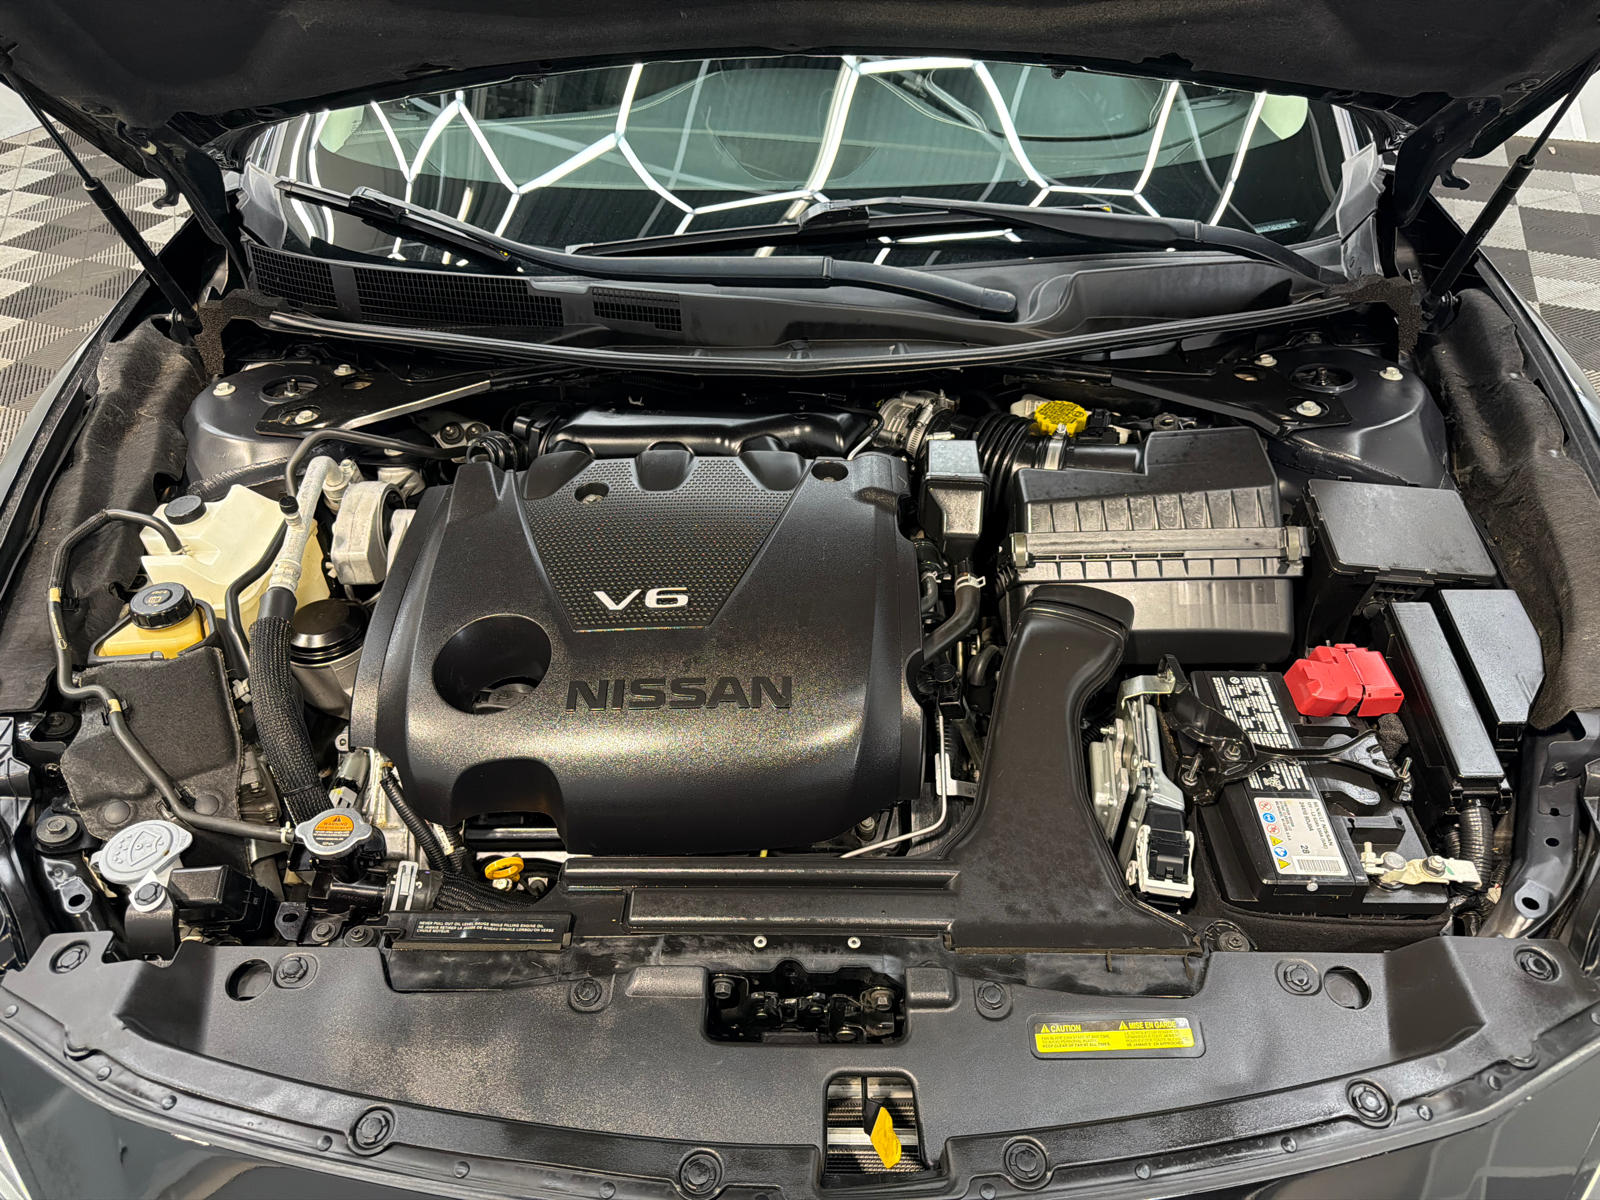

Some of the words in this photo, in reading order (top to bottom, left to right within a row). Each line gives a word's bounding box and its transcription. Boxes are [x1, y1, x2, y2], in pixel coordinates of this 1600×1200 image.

[593, 587, 689, 611] V6
[566, 677, 791, 712] NISSAN
[1313, 802, 1325, 822] RENAULT
[1322, 824, 1333, 846] NISSAN
[1300, 844, 1310, 854] 28
